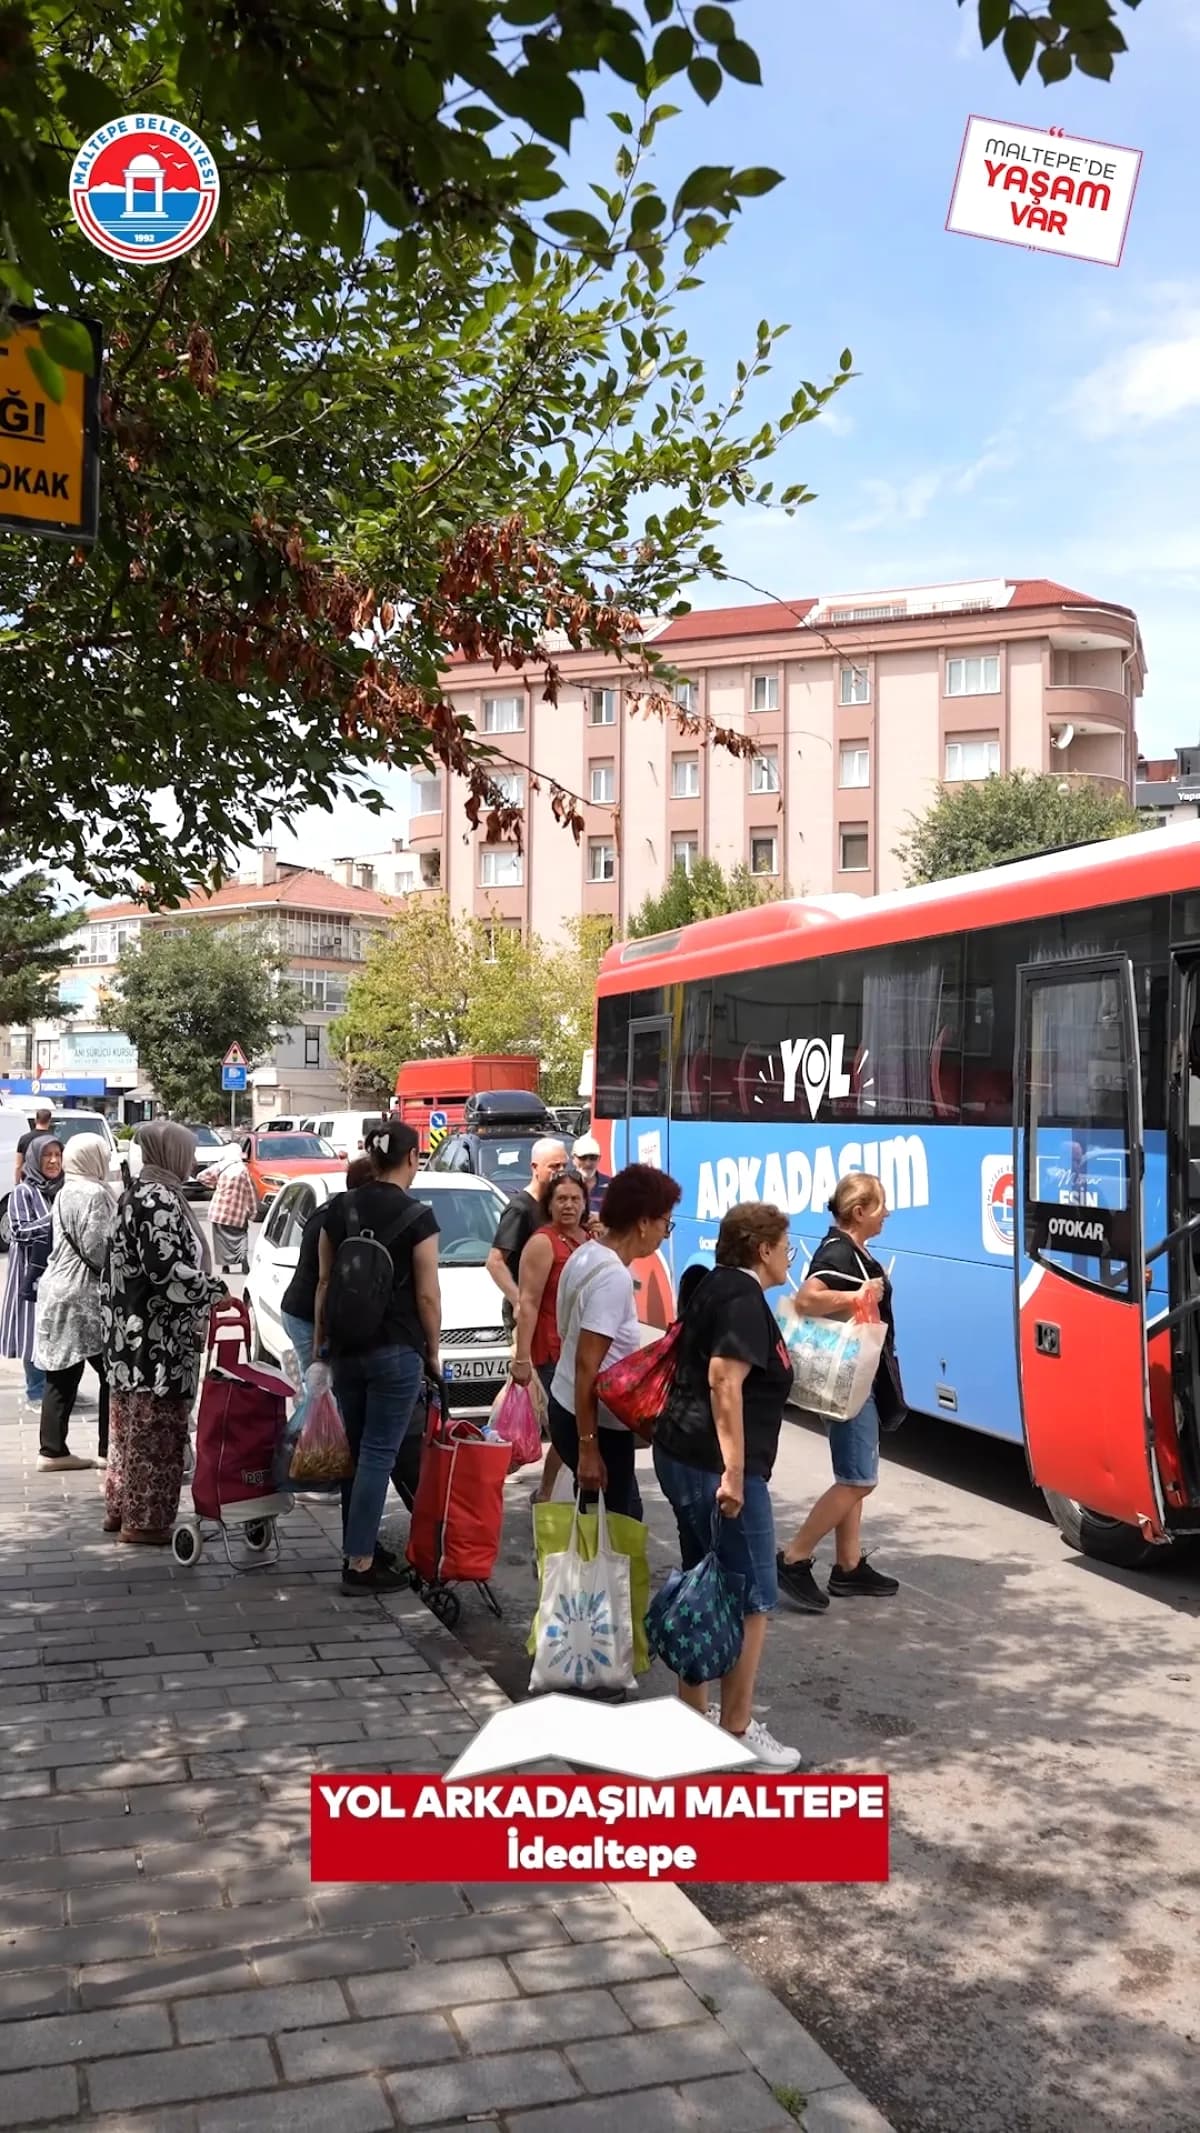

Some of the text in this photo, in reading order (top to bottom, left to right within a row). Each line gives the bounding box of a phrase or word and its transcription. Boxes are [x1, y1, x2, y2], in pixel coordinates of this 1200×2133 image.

[780, 1034, 850, 1120] YOL
[1049, 1218, 1104, 1240] OTOKAR
[454, 1362, 471, 1378] 34
[473, 1361, 495, 1377] DV
